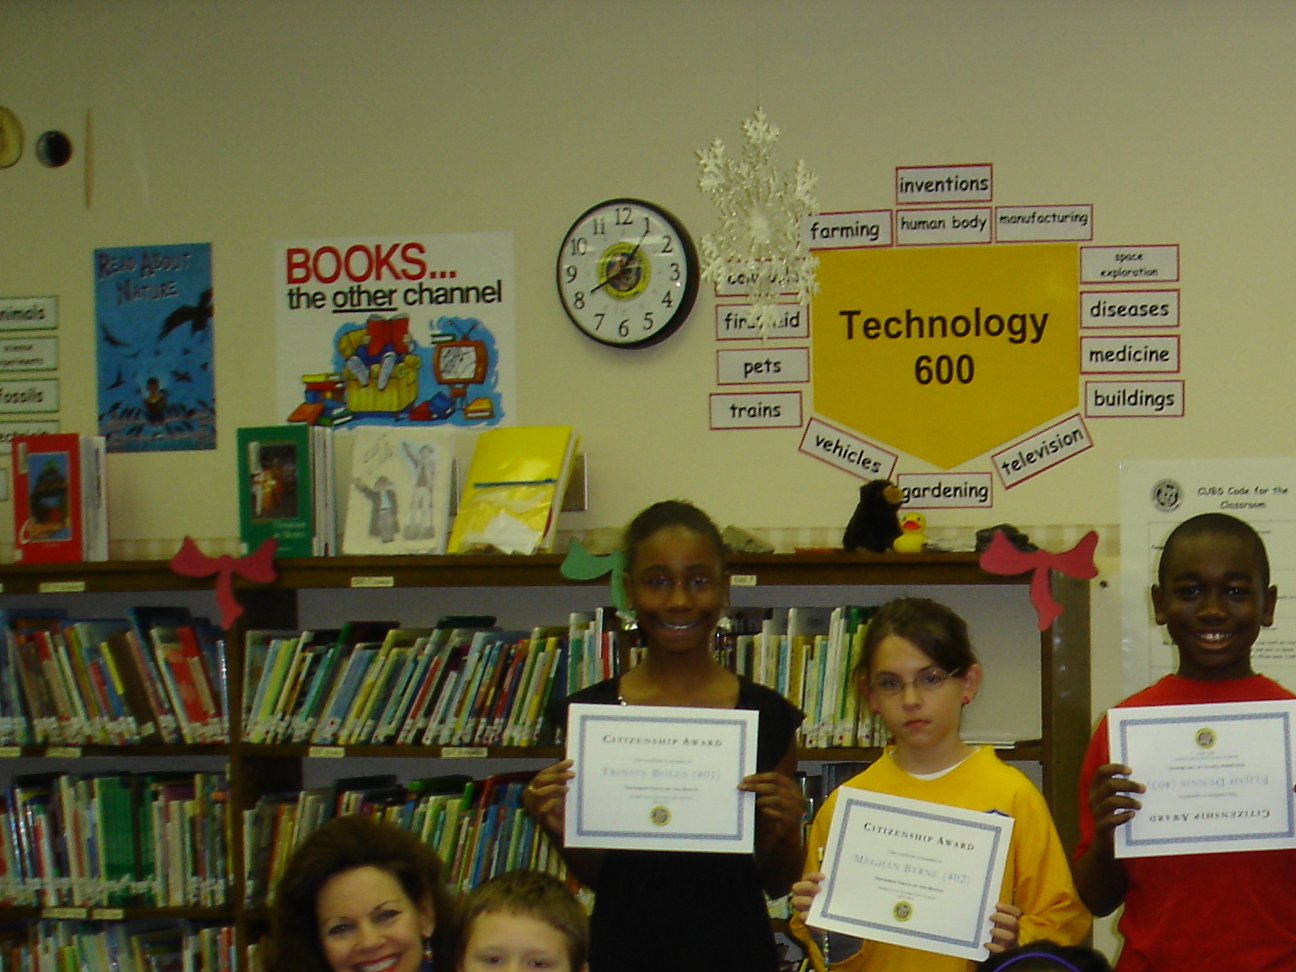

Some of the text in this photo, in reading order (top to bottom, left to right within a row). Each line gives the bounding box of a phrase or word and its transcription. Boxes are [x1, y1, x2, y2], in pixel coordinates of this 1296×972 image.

[899, 175, 989, 194] inventions
[615, 207, 633, 225] 12
[643, 217, 651, 233] 1
[900, 215, 987, 234] human body
[999, 211, 1089, 228] manufacturing
[810, 219, 880, 243] farming
[571, 237, 587, 256] 10
[661, 235, 673, 253] 2
[286, 242, 457, 284] BOOKS...
[1114, 252, 1144, 264] space
[566, 265, 577, 283] 9
[670, 263, 681, 281] 3
[1100, 266, 1158, 279] exploration
[288, 279, 502, 310] the other channel
[574, 291, 585, 309] 8
[661, 290, 673, 308] 4
[1090, 300, 1169, 319] diseases
[594, 313, 606, 331] 7
[618, 319, 630, 337] 6
[643, 312, 654, 330] 5
[839, 307, 1050, 344] Technology
[1089, 344, 1170, 364] medicine
[743, 357, 782, 377] pets
[914, 354, 975, 385] 600
[1093, 389, 1175, 411] buildings
[730, 402, 781, 420] trains
[814, 432, 882, 474] vehicles
[1000, 426, 1085, 476] television
[900, 482, 989, 504] gardening
[602, 734, 723, 747] CITIZENSHIP AWARD
[1148, 809, 1271, 823] CITIZENSHIP AWARD
[863, 822, 975, 851] CITIZENSHIP AWARD
